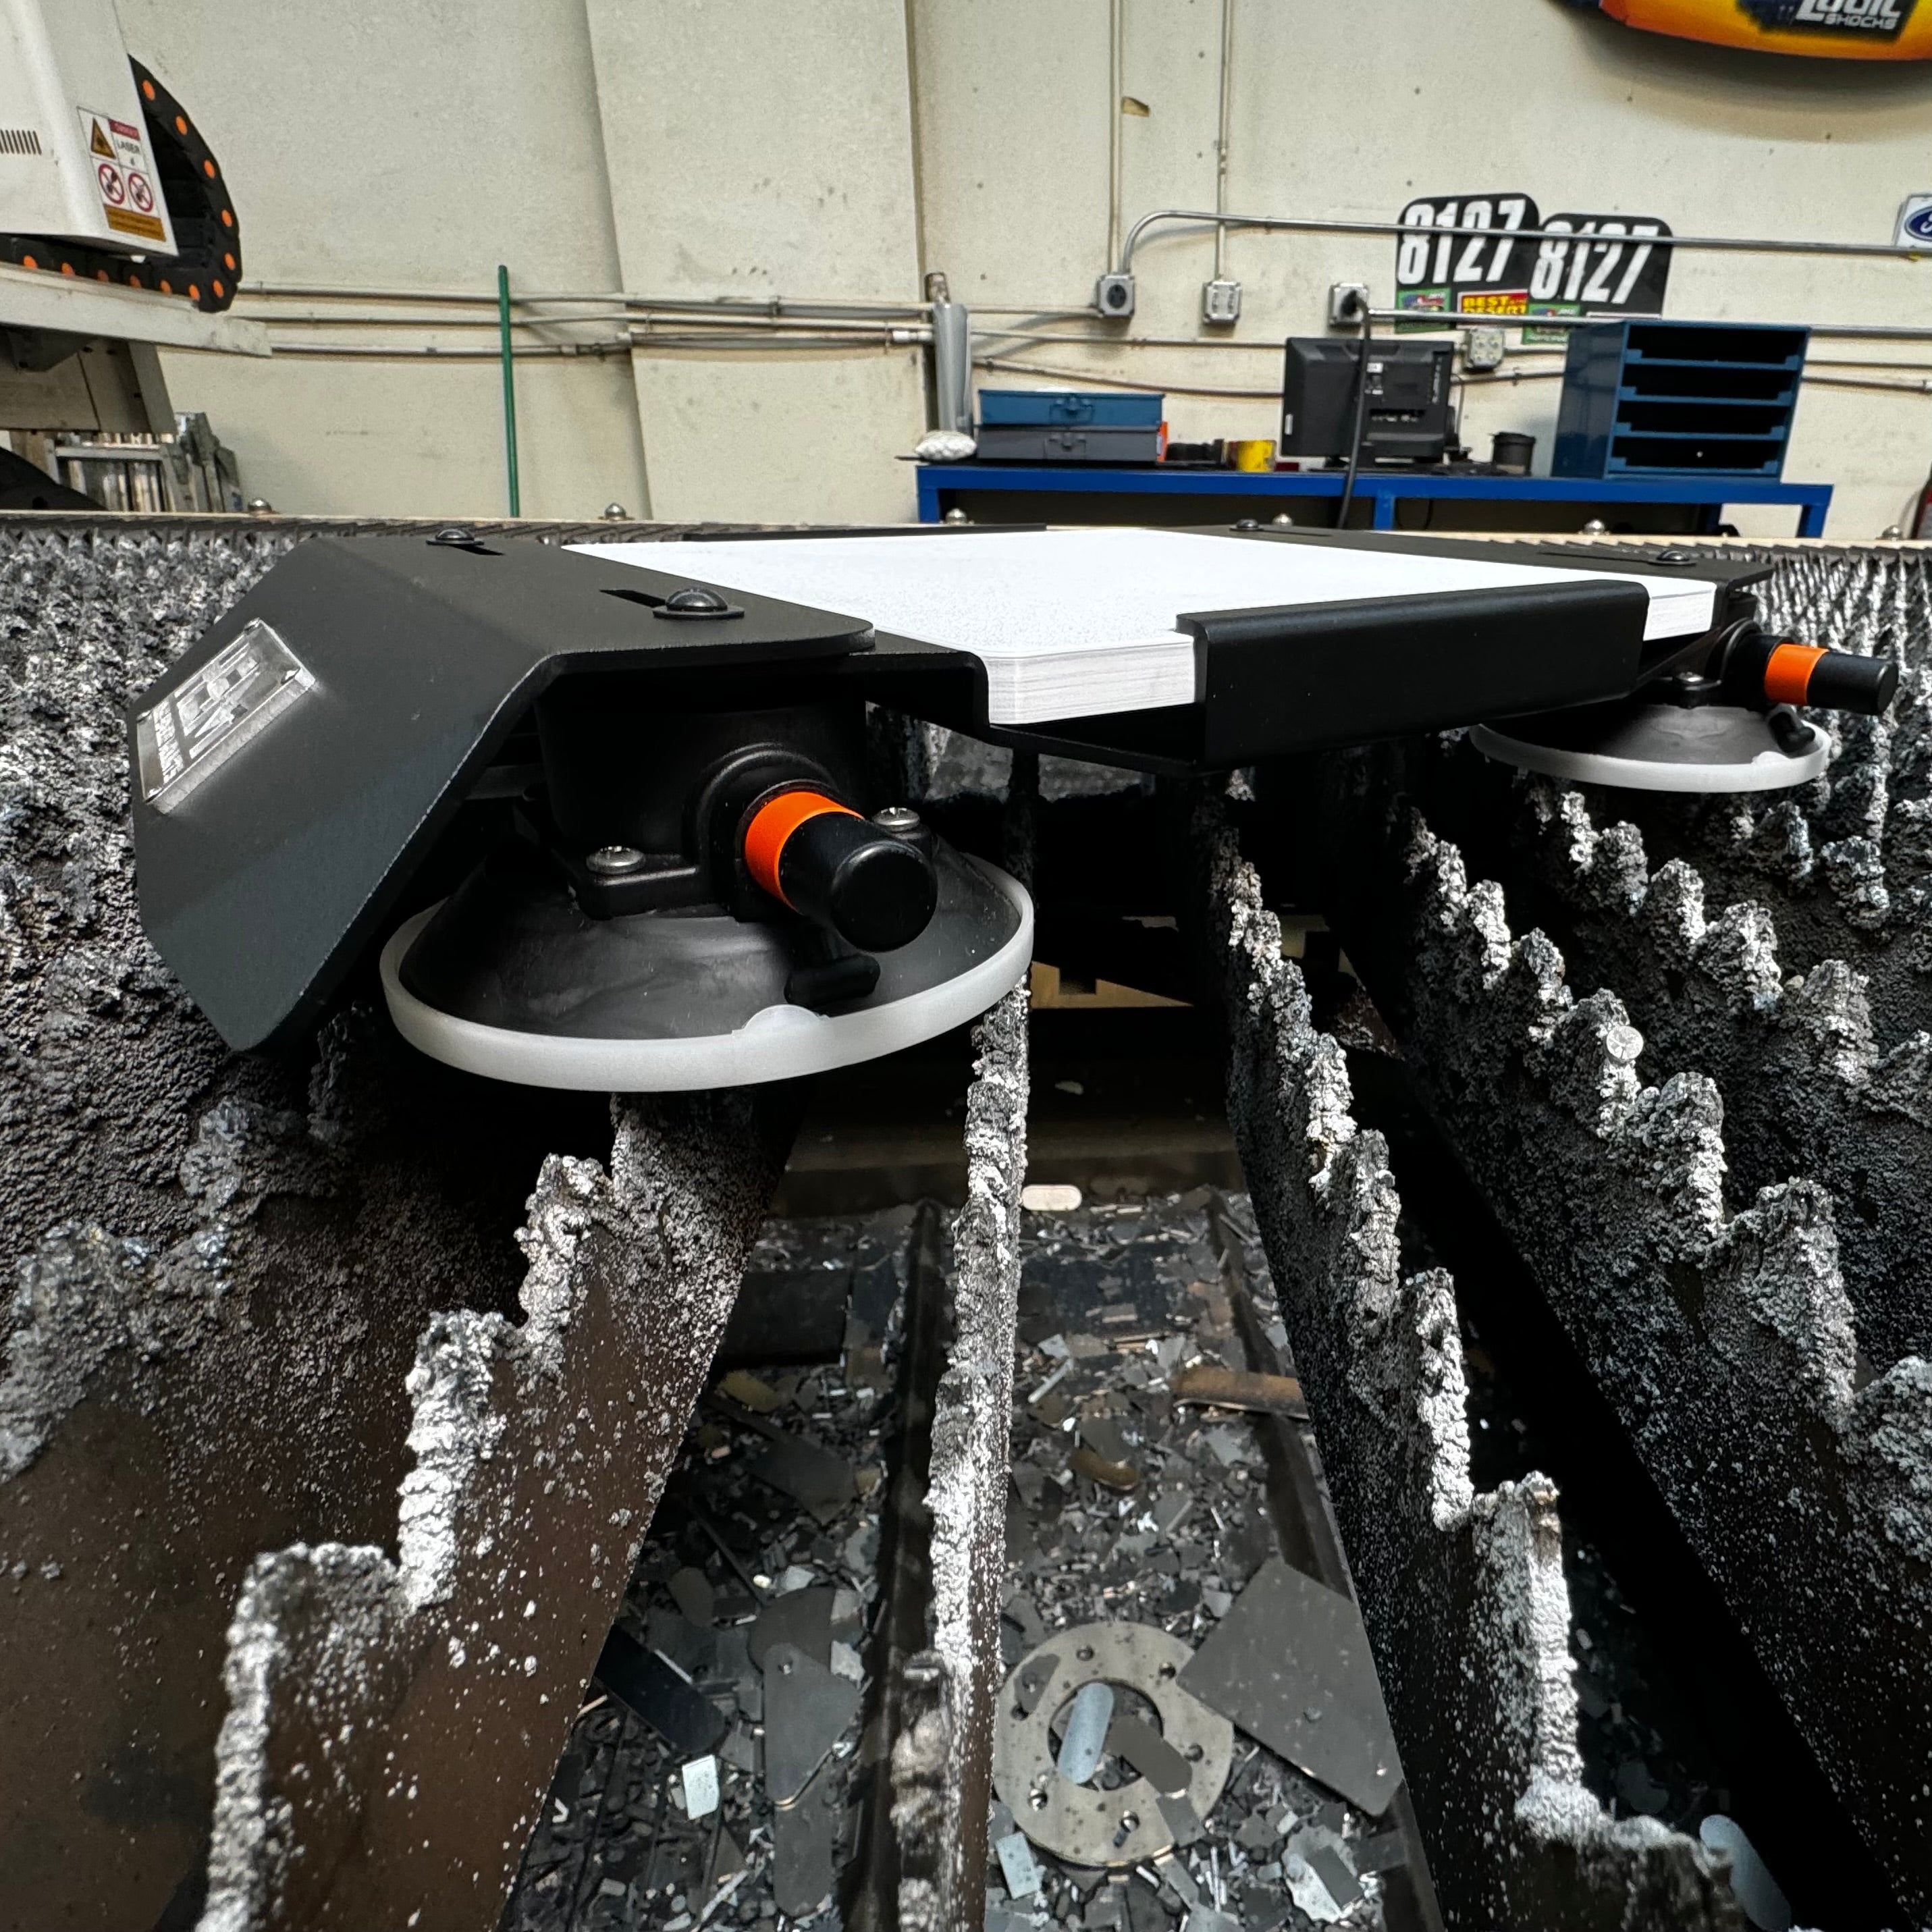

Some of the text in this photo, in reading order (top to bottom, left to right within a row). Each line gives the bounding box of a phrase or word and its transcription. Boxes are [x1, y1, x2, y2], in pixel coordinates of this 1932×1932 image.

[1823, 13, 1898, 30] SHOCKS
[1398, 199, 1526, 284] 8127
[1530, 220, 1659, 304] 8127
[1463, 296, 1509, 308] BEST
